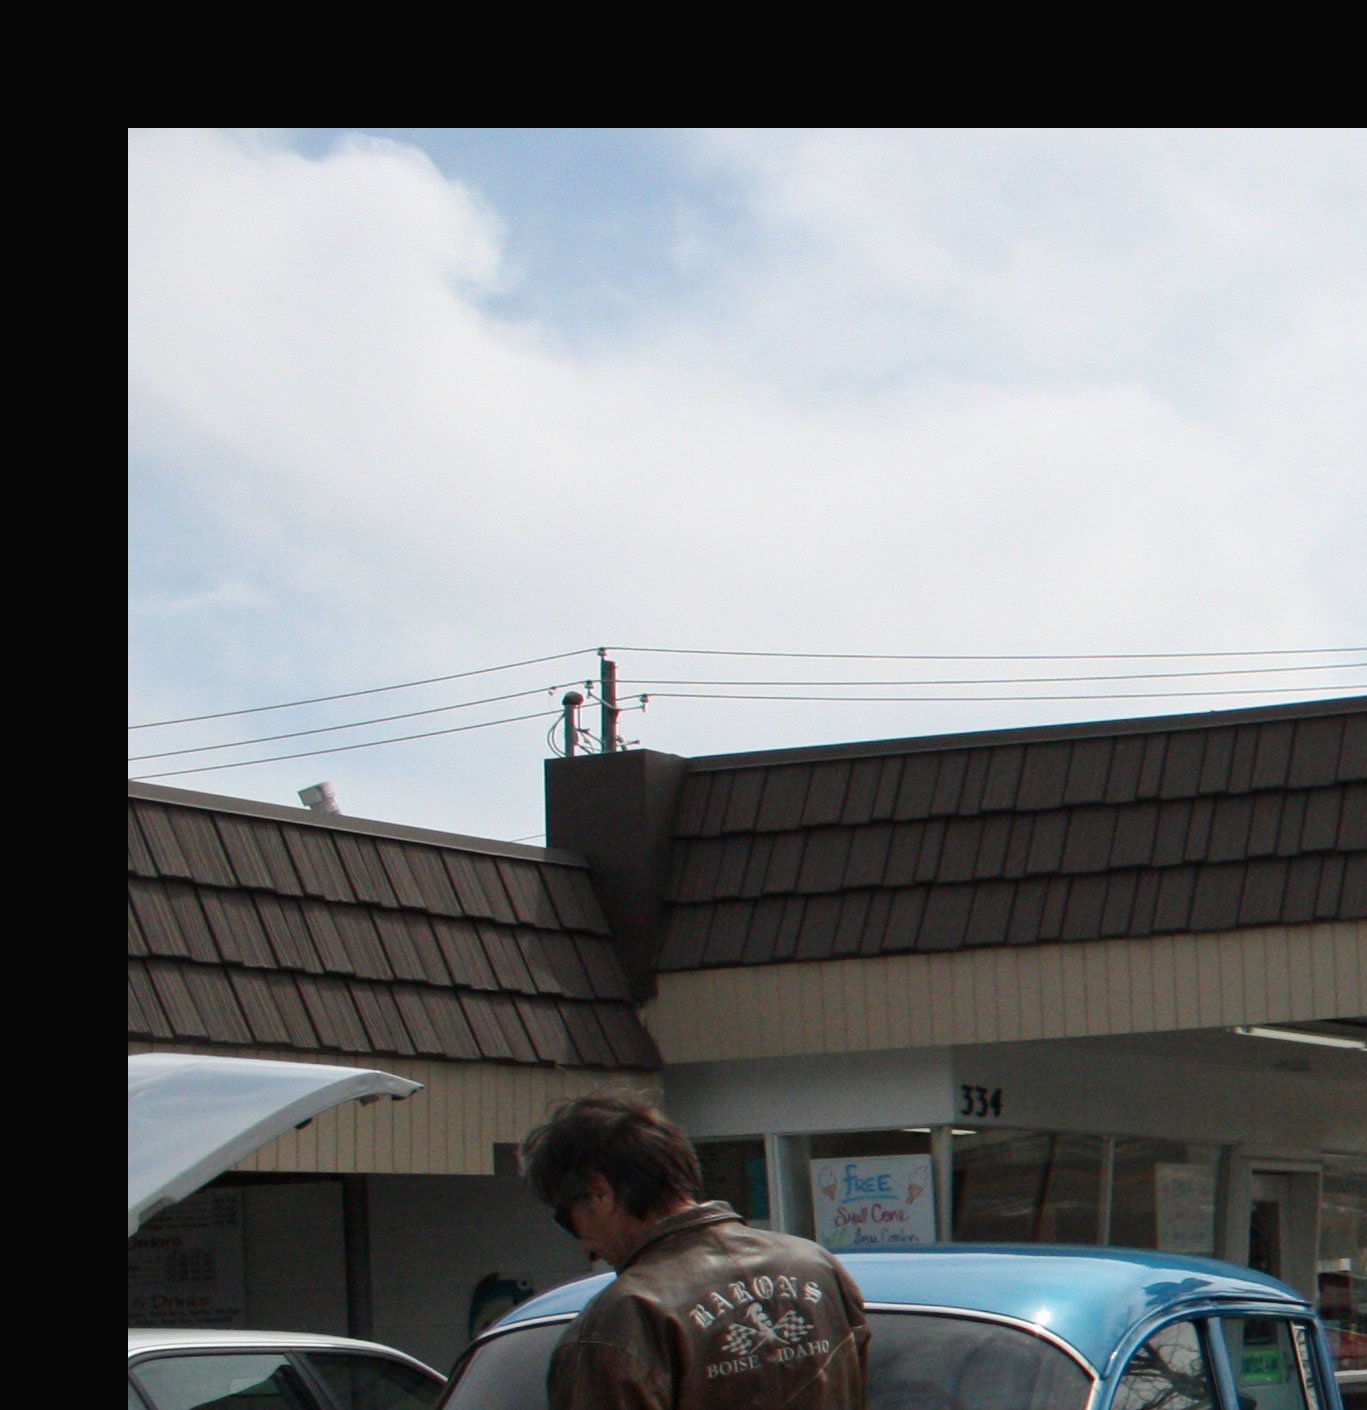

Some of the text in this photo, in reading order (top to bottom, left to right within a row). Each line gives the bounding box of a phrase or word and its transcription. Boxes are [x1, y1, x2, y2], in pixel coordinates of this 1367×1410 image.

[961, 1083, 1003, 1118] 334
[690, 1275, 823, 1330] BARONS
[707, 1340, 830, 1379] BOISE IDAHO
